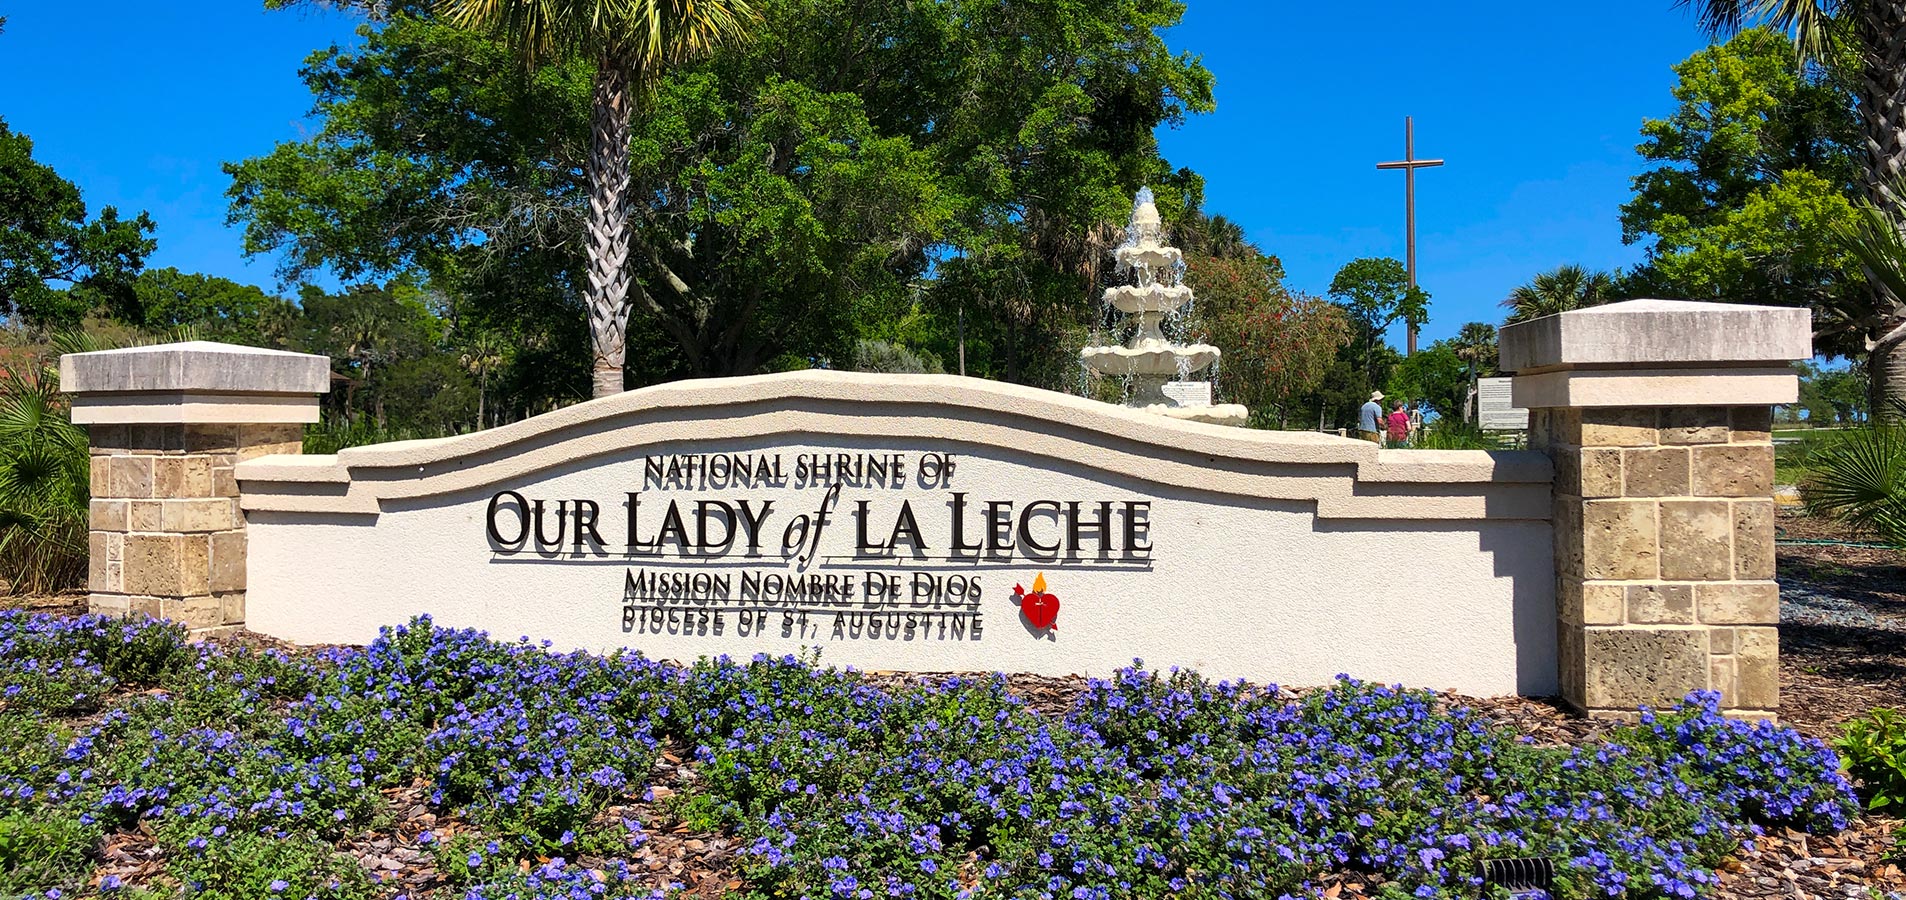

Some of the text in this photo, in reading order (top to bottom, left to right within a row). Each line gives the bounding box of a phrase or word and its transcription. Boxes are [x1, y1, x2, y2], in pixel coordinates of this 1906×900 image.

[645, 453, 956, 479] NATIONAL SHRINE OF
[486, 483, 1153, 562] OUR LADY of LA LECHE
[624, 568, 982, 598] MISSION NOMBRE DE DIOS
[623, 607, 725, 626] DIOCESE
[739, 609, 767, 626] OF
[832, 611, 984, 630] AUGUSTINE
